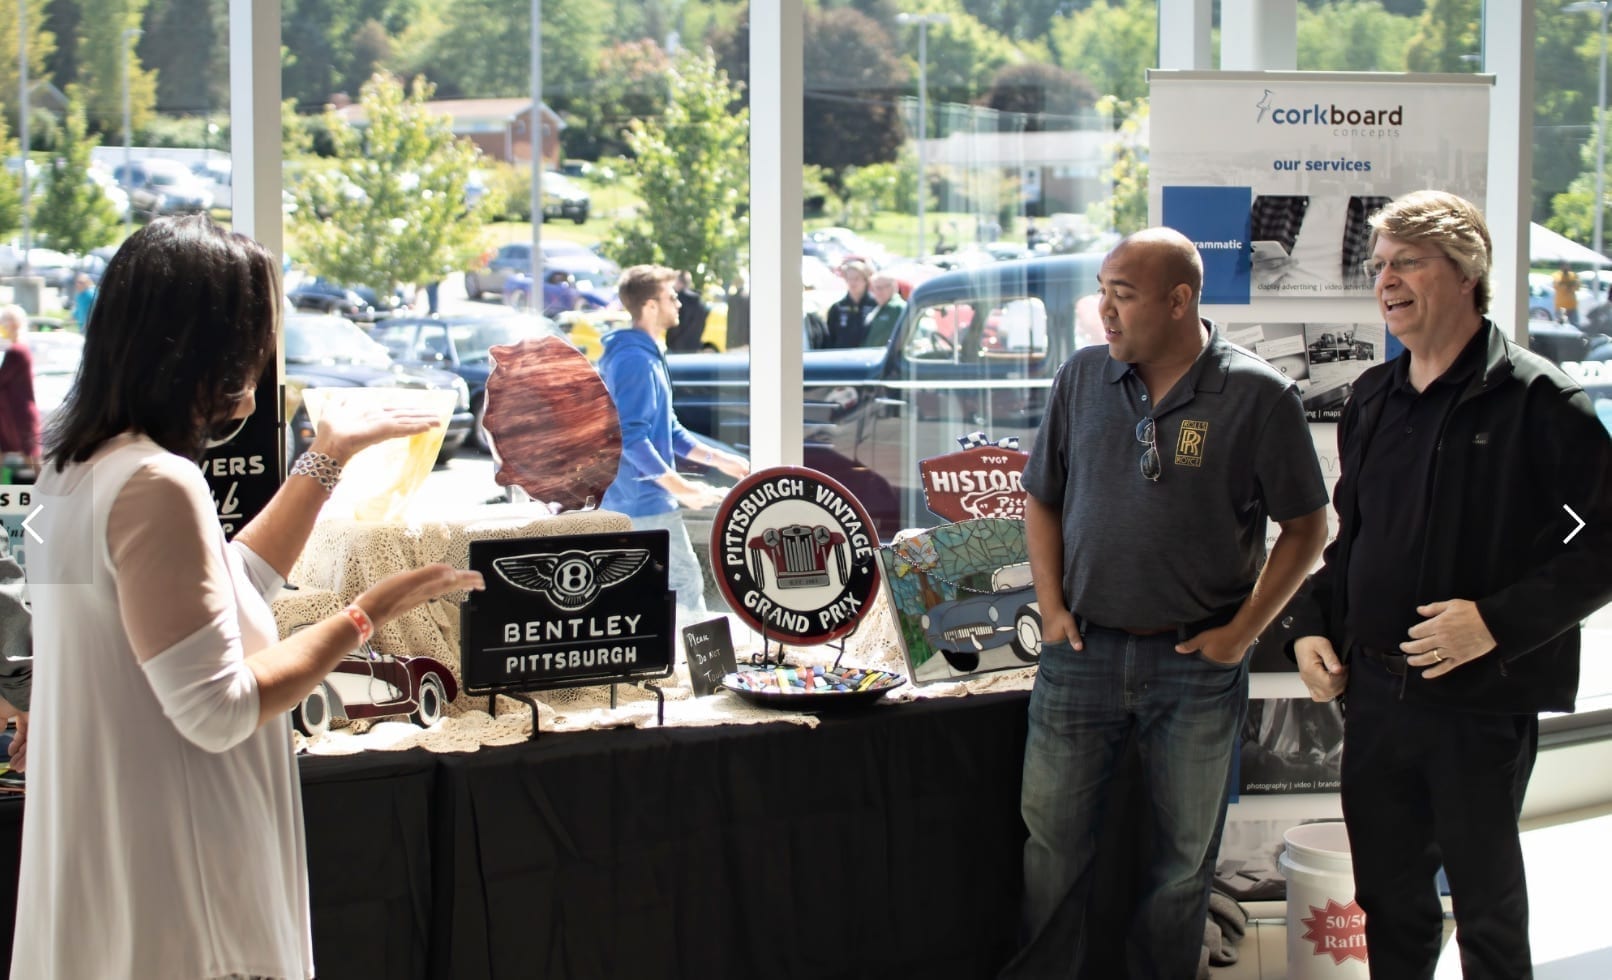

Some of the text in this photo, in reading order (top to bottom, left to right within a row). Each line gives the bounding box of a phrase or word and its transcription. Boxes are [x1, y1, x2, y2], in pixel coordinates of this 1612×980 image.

[1271, 104, 1403, 126] corkboard
[1332, 128, 1401, 138] concepts
[1273, 157, 1372, 172] our services
[1194, 239, 1243, 249] rammatic
[1281, 282, 1318, 292] advertising
[1324, 282, 1343, 290] video
[1323, 410, 1341, 419] maps
[930, 469, 1026, 492] HISTOR
[725, 478, 873, 567] PITTSBURGH VINTAGE
[744, 590, 862, 633] GRAND PRIX
[504, 614, 642, 643] BENTLEY
[506, 646, 638, 673] PITTSBURGH
[1246, 781, 1288, 791] photography
[1293, 781, 1312, 789] video
[1325, 933, 1368, 949] Raffl
